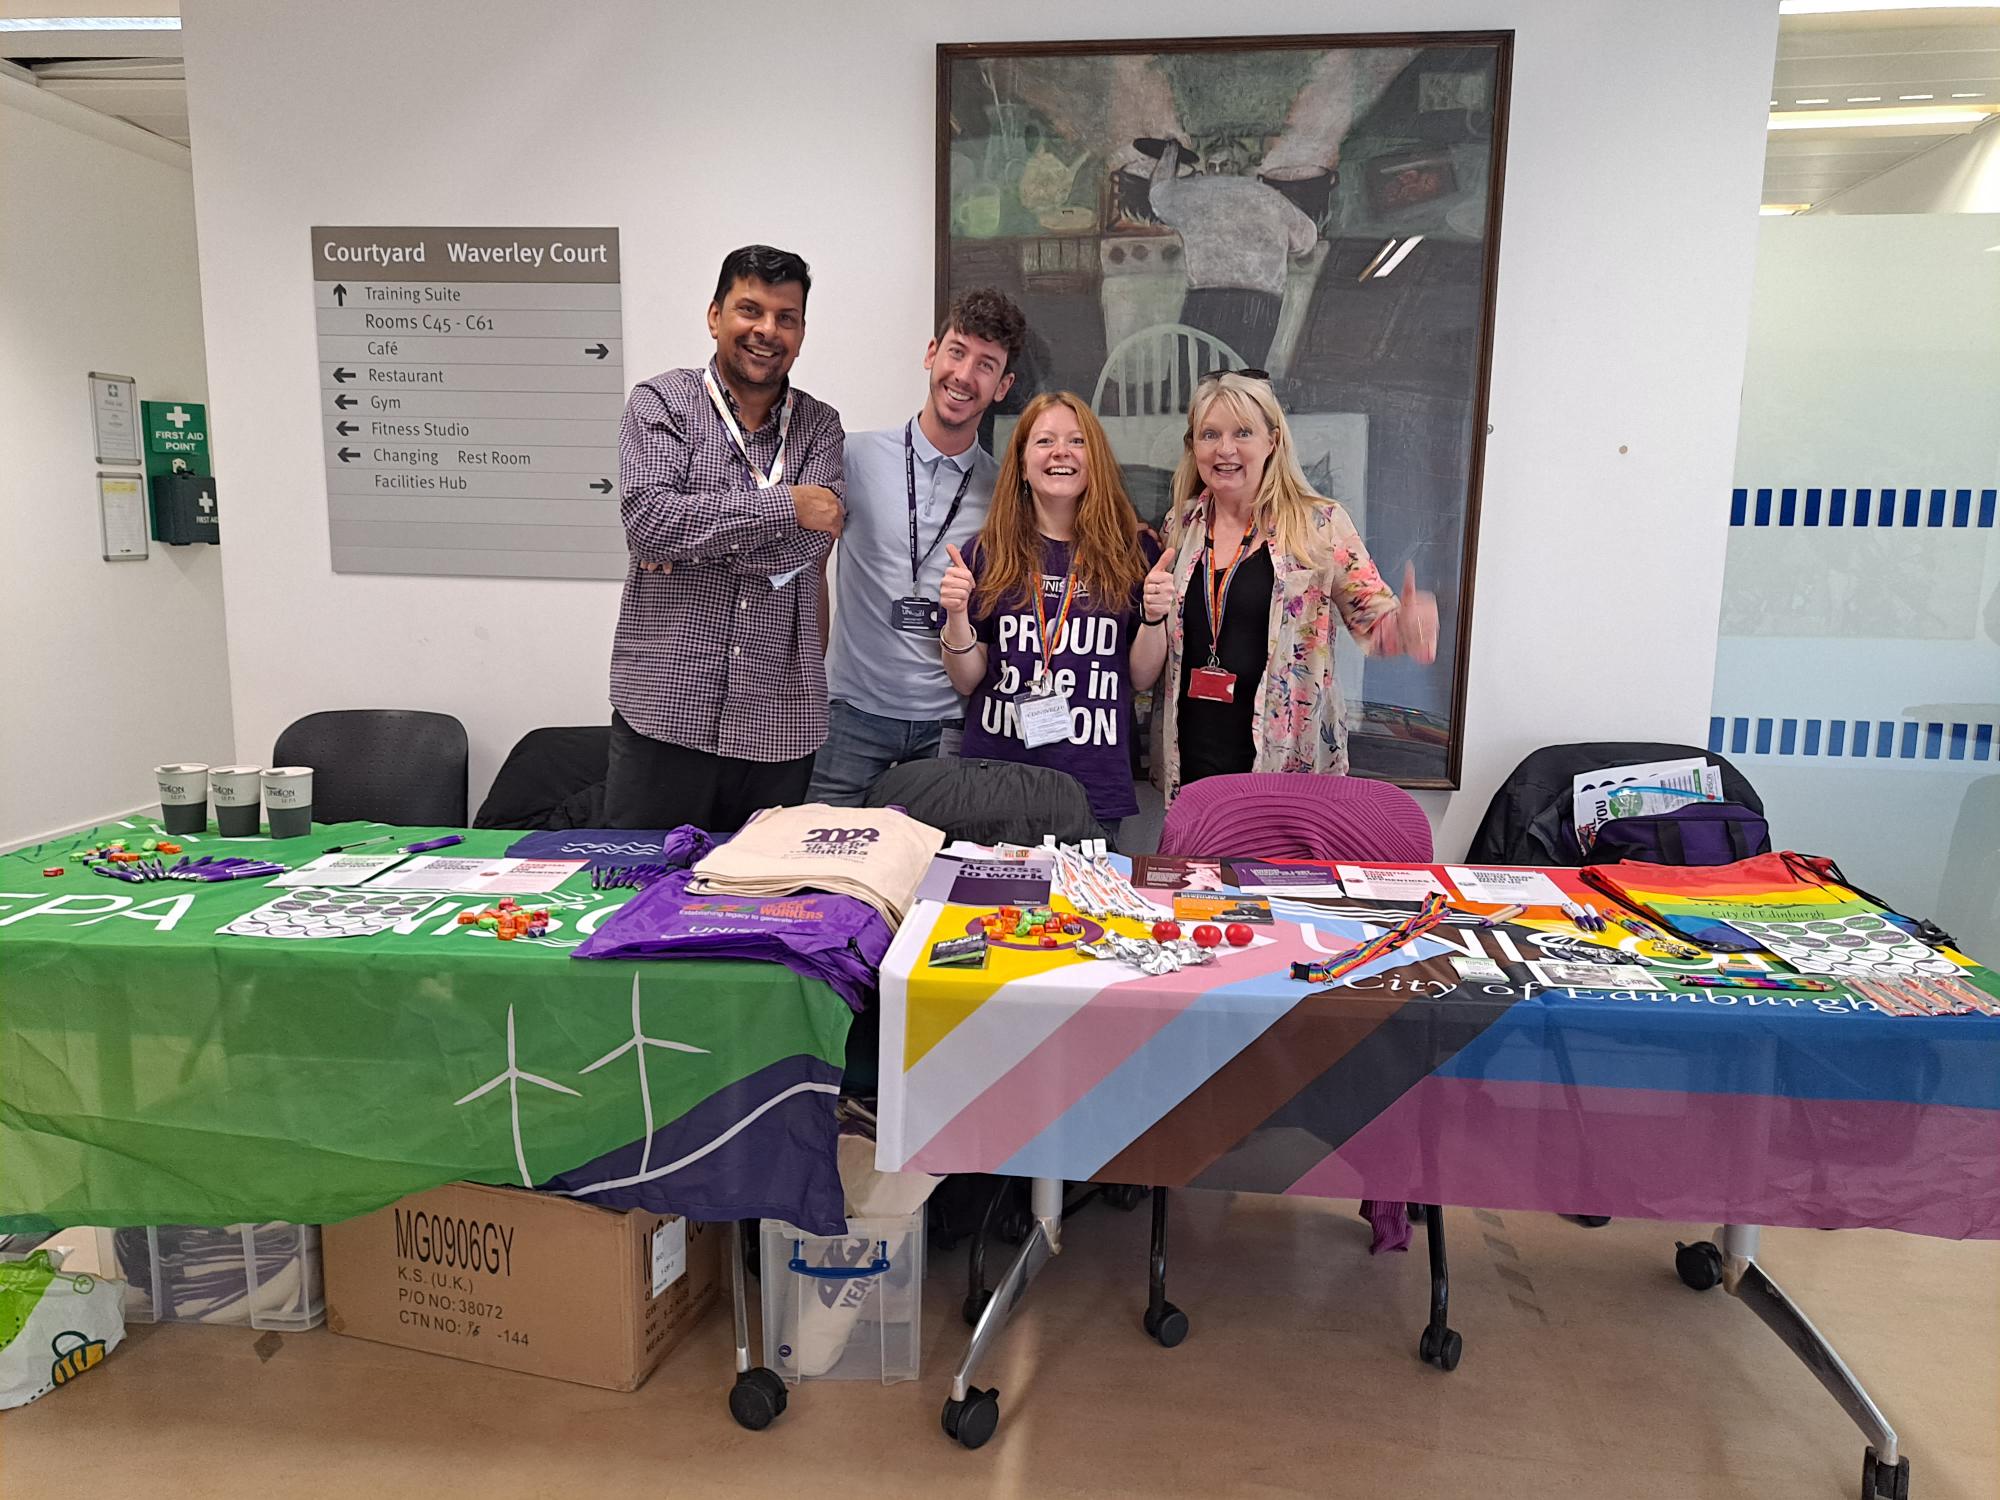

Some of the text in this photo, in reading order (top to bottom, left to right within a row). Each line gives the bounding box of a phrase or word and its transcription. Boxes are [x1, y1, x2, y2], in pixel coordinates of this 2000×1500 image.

[324, 242, 426, 267] Courtyard
[447, 242, 608, 268] Waverley Court
[366, 286, 461, 304] Training Suite
[365, 313, 418, 330] Rooms
[422, 313, 451, 333] C45
[465, 314, 494, 331] C61
[367, 341, 398, 355] Café
[369, 368, 444, 384] Restaurant
[370, 395, 401, 412] Gym
[155, 431, 204, 441] FIRST AID
[372, 422, 469, 437] Fitness Studio
[165, 442, 197, 451] POINT
[373, 448, 439, 466] Changing
[458, 450, 531, 465] Rest Room
[375, 475, 467, 491] Facilities Hub
[999, 615, 1118, 656] PROUD
[1088, 661, 1119, 700] in
[1595, 800, 1609, 825] YOU
[960, 864, 1042, 873] Access
[986, 872, 1044, 880] work
[725, 911, 749, 920] legacy
[759, 906, 824, 920] WORKERS
[1711, 908, 1826, 921] City of Edinburgh
[1343, 973, 1880, 1015] City of Edinburgh
[394, 1207, 514, 1277] MG0906GY
[398, 1265, 474, 1295] K.S. (U.K.)
[399, 1287, 504, 1320] P/O NO: 38072
[399, 1309, 461, 1335] CTN NO:
[497, 1328, 530, 1347] -144
